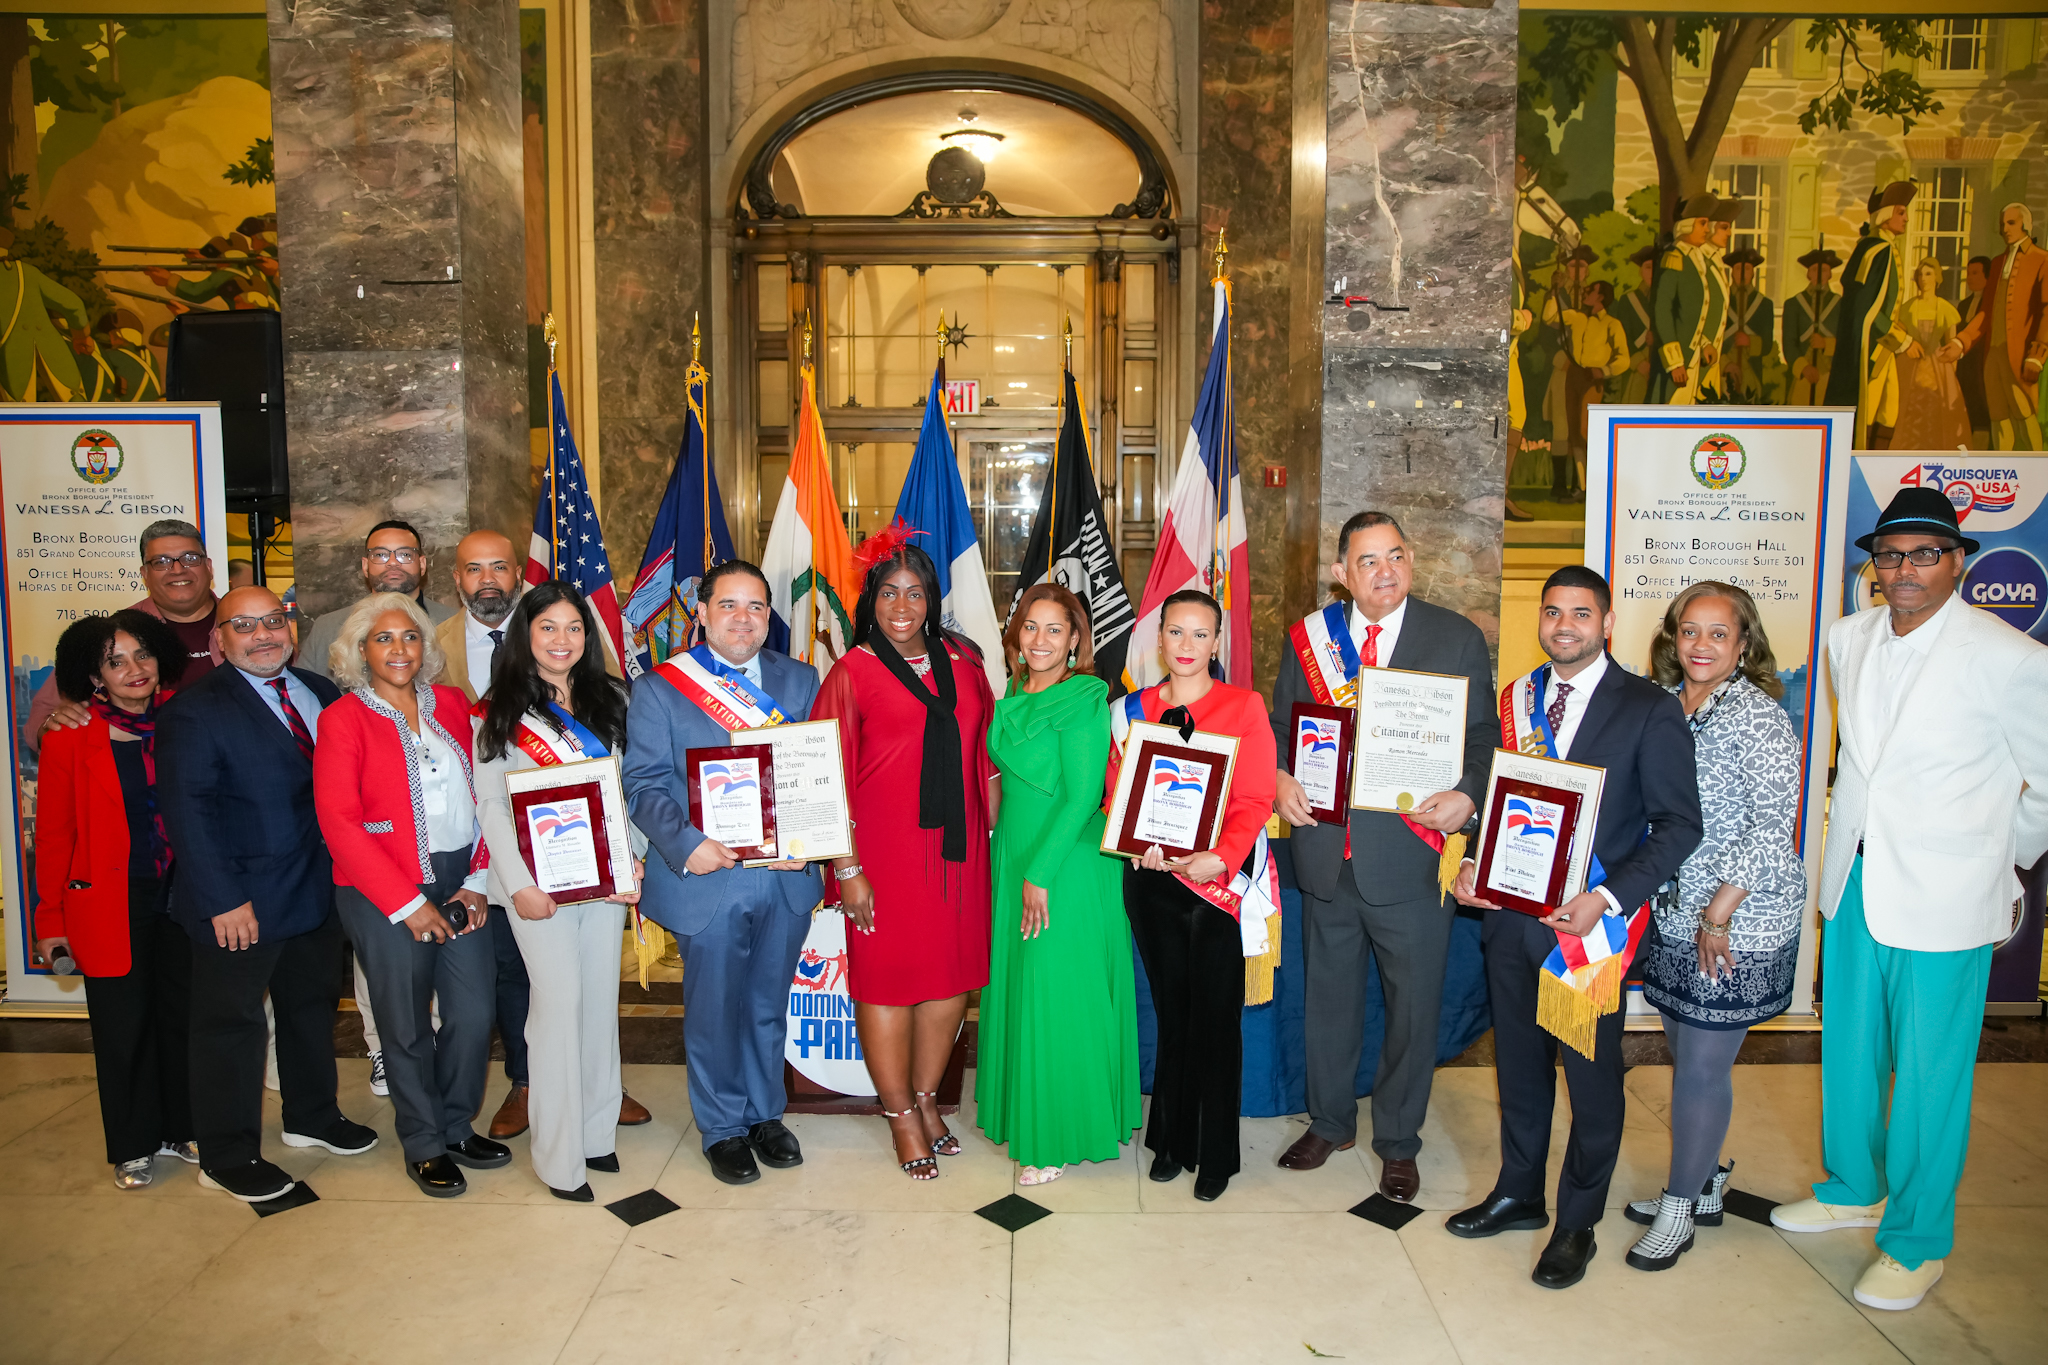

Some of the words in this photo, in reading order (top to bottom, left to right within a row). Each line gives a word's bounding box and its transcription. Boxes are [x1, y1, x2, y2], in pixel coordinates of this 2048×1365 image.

[946, 383, 975, 412] XIT
[1942, 469, 2018, 481] QUISQUEYA
[1982, 482, 2011, 494] USA
[16, 503, 91, 515] VANESSA
[120, 503, 184, 515] GIBSON
[1628, 508, 1706, 521] VANESSA
[1738, 509, 1806, 522] GIBSON
[33, 532, 75, 544] BRONX
[79, 532, 137, 544] BOROUGH
[1645, 538, 1687, 550] BRONX
[1692, 538, 1751, 550] BOROUGH
[1757, 539, 1787, 551] HALL
[16, 549, 34, 558] 851
[39, 549, 75, 558] GRAND
[78, 549, 136, 558] CONCOURSE
[1624, 555, 1644, 565] 851
[1650, 555, 1684, 565] GRAND
[1688, 555, 1749, 566] CONCOURSE
[1753, 556, 1779, 566] SUITE
[1784, 556, 1805, 566] 301
[28, 568, 68, 579] OFFICE
[72, 568, 113, 579] HOURS:
[18, 581, 57, 592] HORAS
[61, 583, 73, 592] DE
[77, 581, 125, 592] OFICINA:
[1637, 575, 1675, 586] OFFICE
[1624, 588, 1662, 600] HORAS
[1971, 582, 2037, 603] GOYA
[1092, 581, 1136, 657] MIA
[1302, 648, 1326, 699] NATIONAL
[1503, 689, 1514, 747] NATIONAL
[1371, 725, 1409, 739] Citation
[1410, 730, 1420, 739] of
[1420, 731, 1450, 744] Merit
